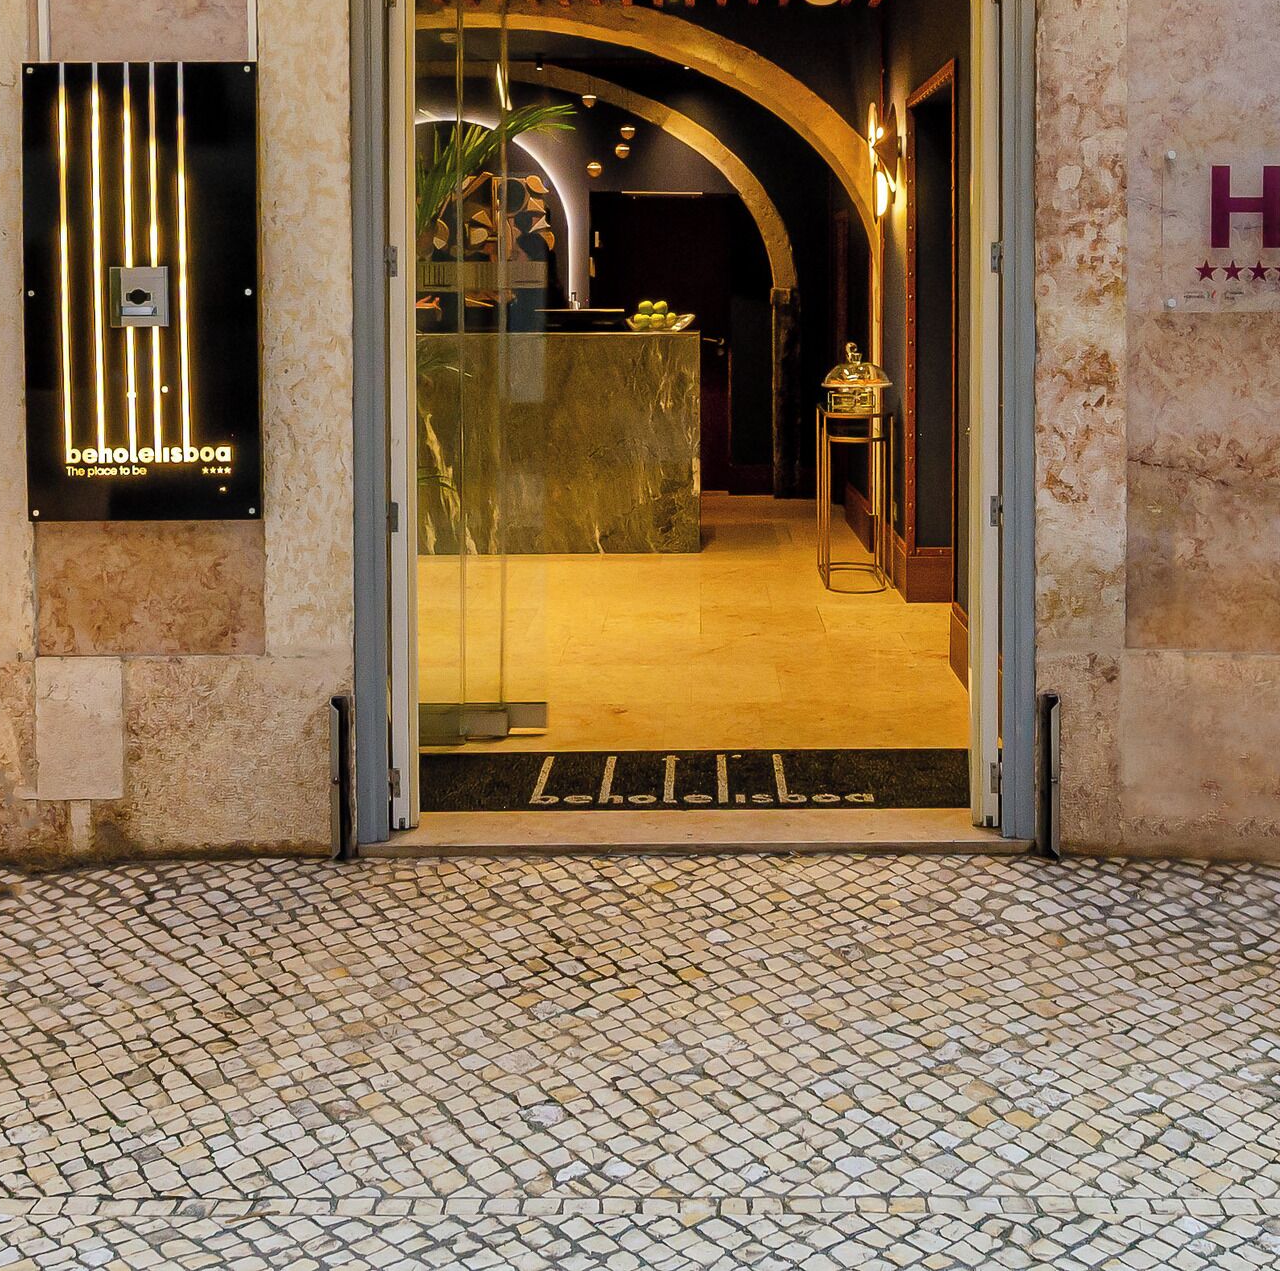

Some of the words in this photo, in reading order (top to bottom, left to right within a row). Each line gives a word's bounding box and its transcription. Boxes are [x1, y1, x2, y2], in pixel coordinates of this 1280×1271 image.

[65, 466, 85, 476] The
[87, 466, 117, 478] place
[119, 466, 130, 475] to
[132, 465, 147, 476] be
